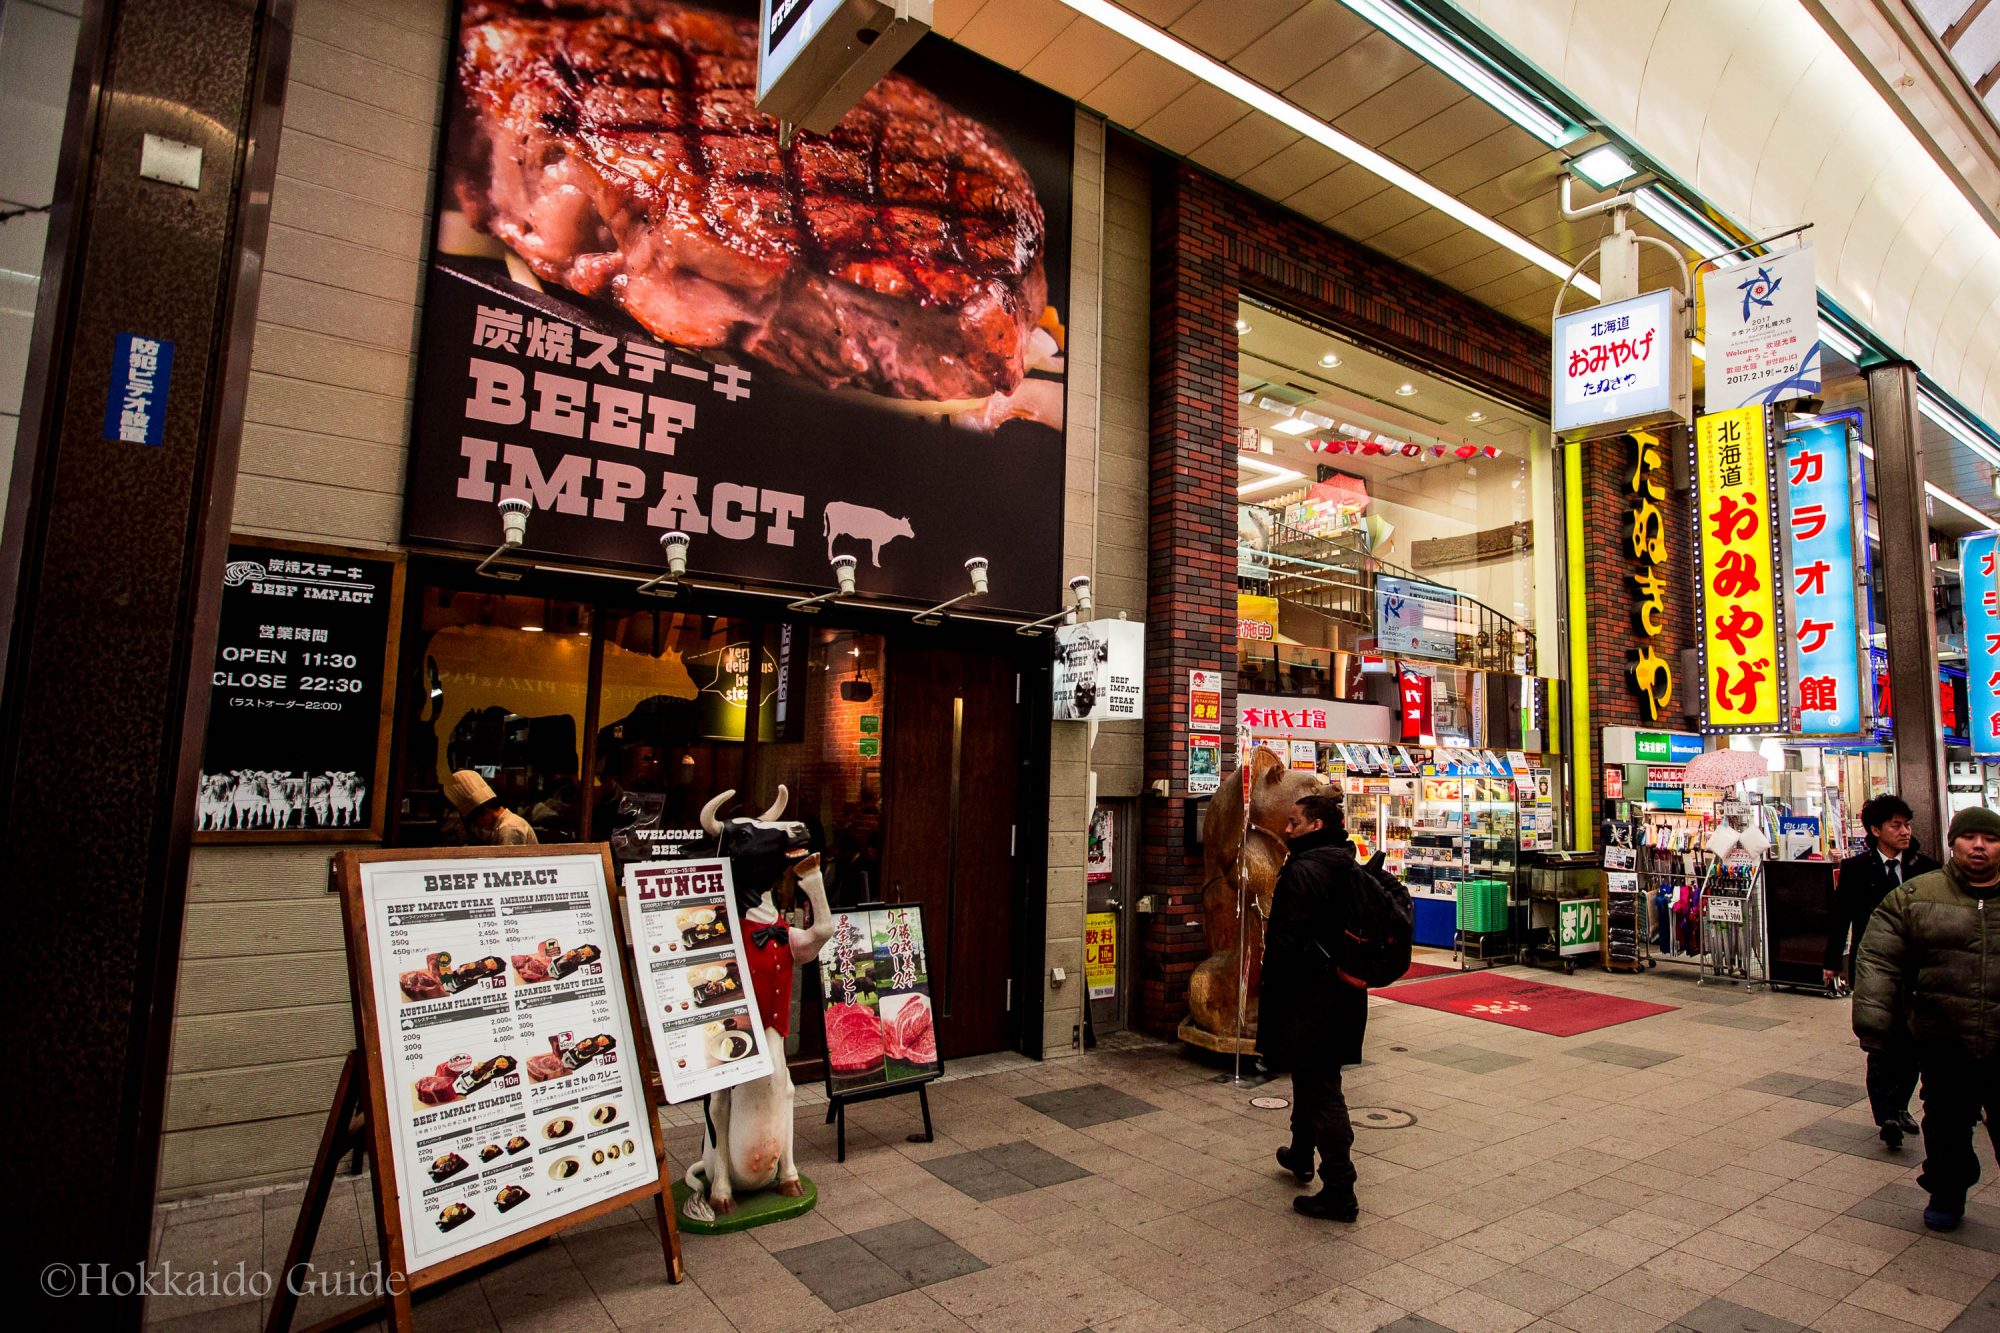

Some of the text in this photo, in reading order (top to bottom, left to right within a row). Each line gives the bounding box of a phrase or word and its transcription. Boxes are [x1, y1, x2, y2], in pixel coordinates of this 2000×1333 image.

[1591, 316, 1630, 337] 北海道
[1752, 315, 1771, 326] 2017
[471, 304, 752, 402] 炭焼ステーキ
[1568, 327, 1656, 378] おみやげ
[1726, 347, 1759, 357] Welcome
[1746, 350, 1777, 362] ようこそ
[1583, 372, 1637, 397] たぬきや
[1727, 369, 1771, 385] 2017.2.19
[119, 336, 160, 444] 防犯ビデオ設置
[465, 356, 697, 456] BEEF
[1717, 420, 1743, 489] 北海道
[456, 435, 805, 548] IMPACT
[268, 558, 363, 580] 炭焼ステーキ
[1625, 425, 1674, 723] たぬきや
[1788, 449, 1838, 714] カラオケ館
[251, 583, 374, 604] BEEF IMPACT
[1708, 491, 1770, 716] おみやげ
[258, 624, 329, 643] 営業時間
[221, 646, 358, 669] OPEN 11:30
[212, 671, 363, 694] CLOSE 22:30
[1062, 670, 1094, 684] IMPACT
[1110, 675, 1129, 685] BEEF
[1109, 684, 1140, 694] IMPACT
[228, 697, 343, 712] (ラストオーダー22:00)
[1109, 696, 1135, 705] STEAK
[1109, 704, 1134, 713] HOUSE
[1193, 703, 1217, 719] 免税
[1638, 741, 1667, 754] 北海道銀行
[635, 829, 704, 840] WELCOME
[424, 869, 558, 893] BEEF IMPACT
[637, 873, 725, 900] LUNCH
[387, 898, 494, 914] BEEF IMPACT STEAK
[500, 895, 534, 906] AMERICAN
[555, 892, 569, 901] BEEF
[570, 891, 589, 900] STEAK
[390, 929, 408, 938] 250g
[391, 938, 410, 947] 350g
[392, 947, 411, 956] 450g
[836, 914, 857, 1007] 黒毛和牛ヒレ
[580, 964, 601, 976] 1g 5円
[480, 978, 506, 989] 1g 7円
[514, 976, 604, 998] JAPANESE WAGYU STEAK
[400, 1001, 453, 1018] AUSTRALIAN
[454, 997, 481, 1009] FILLET
[482, 992, 508, 1004] STEAK
[517, 1013, 533, 1021] 200g
[519, 1022, 534, 1030] 300g
[403, 1033, 421, 1042] 200g
[404, 1043, 422, 1052] 300g
[405, 1053, 423, 1061] 400g
[594, 1054, 617, 1066] 1g 17円
[493, 1075, 520, 1090] 1g 10円
[530, 1069, 619, 1098] ステーキ屋さんのカレー
[413, 1112, 439, 1127] BEEF
[440, 1104, 477, 1121] IMPACT
[478, 1091, 522, 1110] HUMBURG
[418, 1148, 433, 1156] 220g
[418, 1155, 434, 1163] 350g
[483, 1178, 497, 1186] 220g
[484, 1184, 498, 1193] 350g
[424, 1196, 439, 1205] 220g
[425, 1204, 440, 1213] 350g
